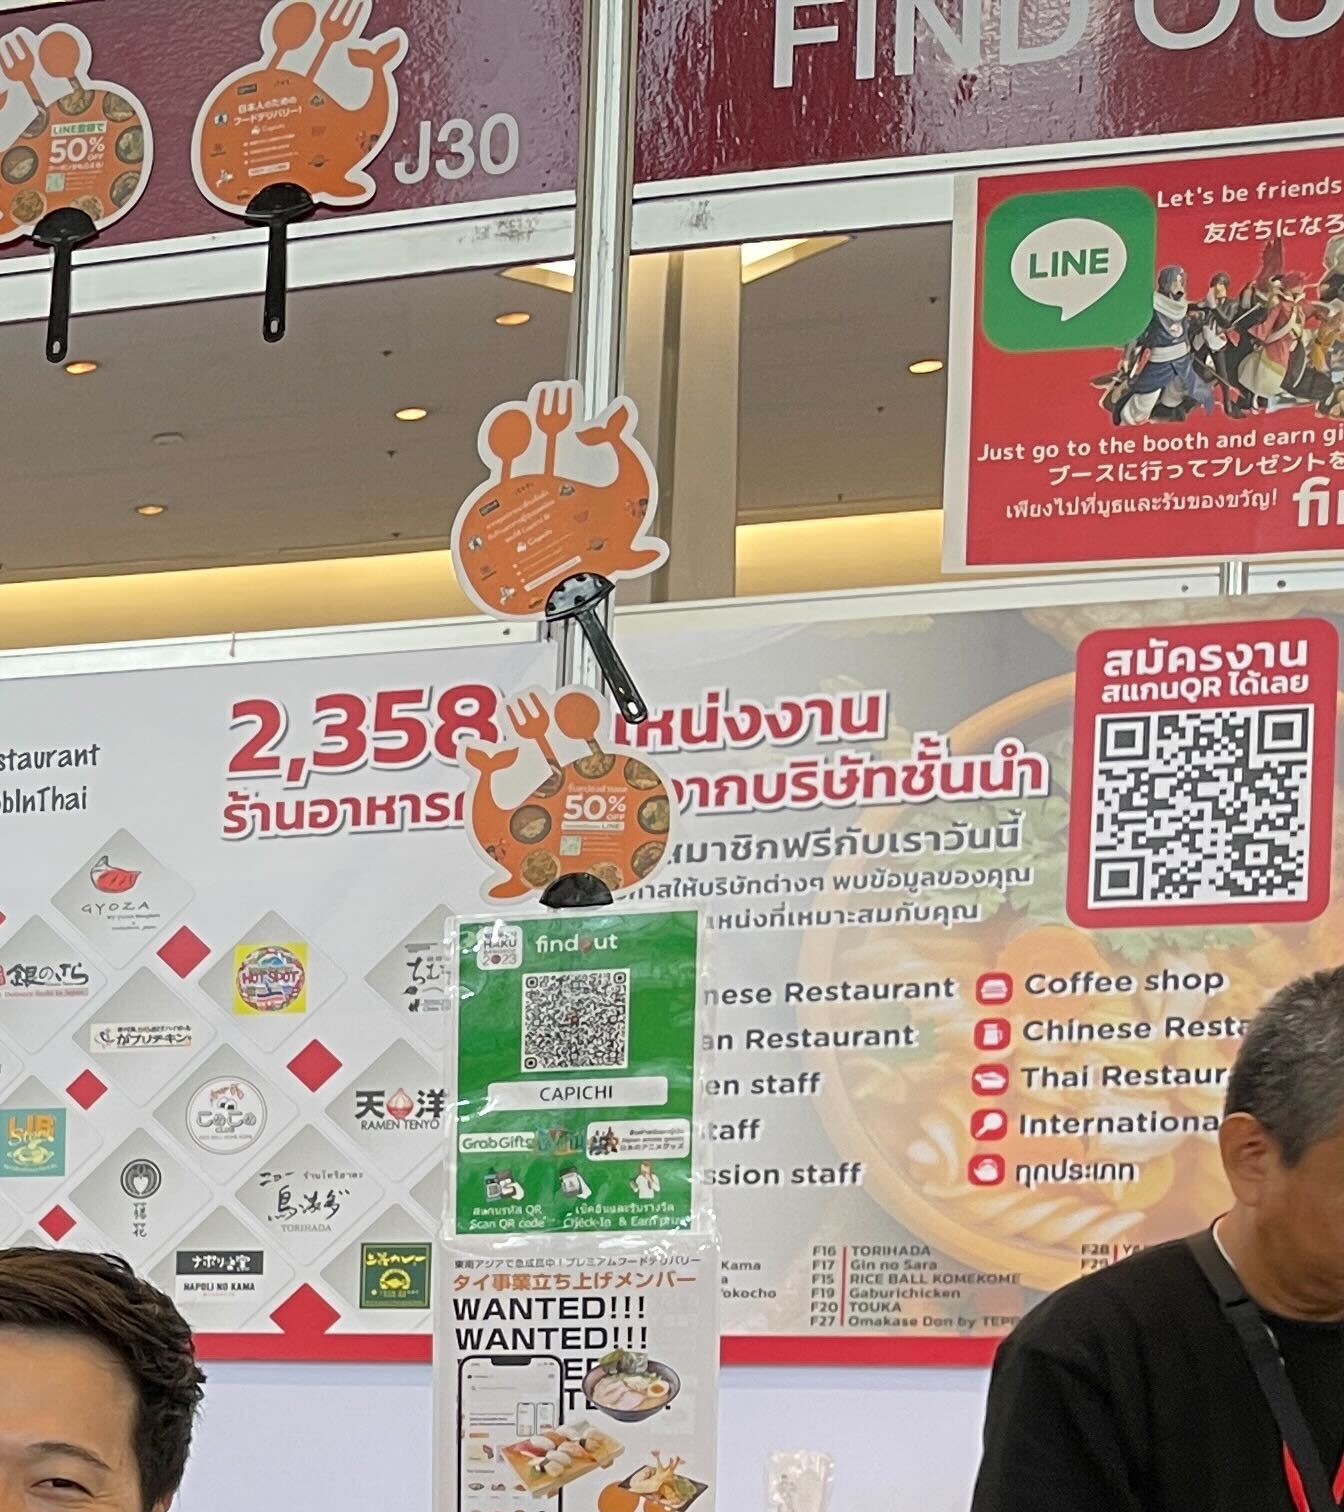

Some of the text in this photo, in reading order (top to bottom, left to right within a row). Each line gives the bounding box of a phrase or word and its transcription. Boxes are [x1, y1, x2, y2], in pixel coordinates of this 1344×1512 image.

[49, 137, 105, 163] 50%
[394, 113, 520, 187] J30
[1156, 176, 1344, 209] Let's be friends
[1028, 247, 1110, 279] LINE
[977, 444, 1025, 462] Just
[1033, 444, 1059, 462] go
[1068, 441, 1091, 456] to
[1099, 437, 1136, 454] the
[1143, 433, 1209, 452] booth
[1216, 430, 1257, 449] and
[1263, 430, 1316, 446] earn
[1103, 638, 1308, 677] สมัครงาน
[228, 683, 502, 782] 2,358
[563, 794, 626, 820] 50%
[81, 901, 149, 914] GYOZA
[242, 970, 300, 984] HOT SPOT
[1025, 969, 1224, 994] Coffee shop
[785, 977, 955, 1003] Restaurant
[746, 1025, 914, 1049] Restaurant
[1023, 1018, 1151, 1041] Chinese
[751, 1072, 821, 1094] staff
[1021, 1066, 1088, 1088] Thai
[540, 1086, 613, 1101] CAPICHI
[362, 1119, 441, 1131] RAMEN TENYO
[791, 1162, 862, 1184] staff
[469, 1217, 545, 1229] Scan QR code
[813, 1245, 931, 1257] F16 TORIHADA
[721, 1260, 761, 1270] Kama
[813, 1260, 938, 1271] F17 Gin no Sara
[231, 1282, 256, 1291] KAMA
[453, 1270, 696, 1292] タイ事業立ち上げメンバー
[850, 1273, 885, 1285] RICE
[889, 1273, 928, 1285] BALL
[933, 1273, 1021, 1284] KOMEKOME
[812, 1287, 961, 1299] F19 Gaburichicken
[453, 1296, 644, 1321] WANTED!!!
[811, 1302, 901, 1313] F20 TOUKA
[810, 1316, 836, 1326] F27
[848, 1316, 913, 1327] Omakase
[922, 1316, 953, 1327] Don
[957, 1316, 976, 1329] by
[455, 1326, 647, 1350] WANTED!!!
